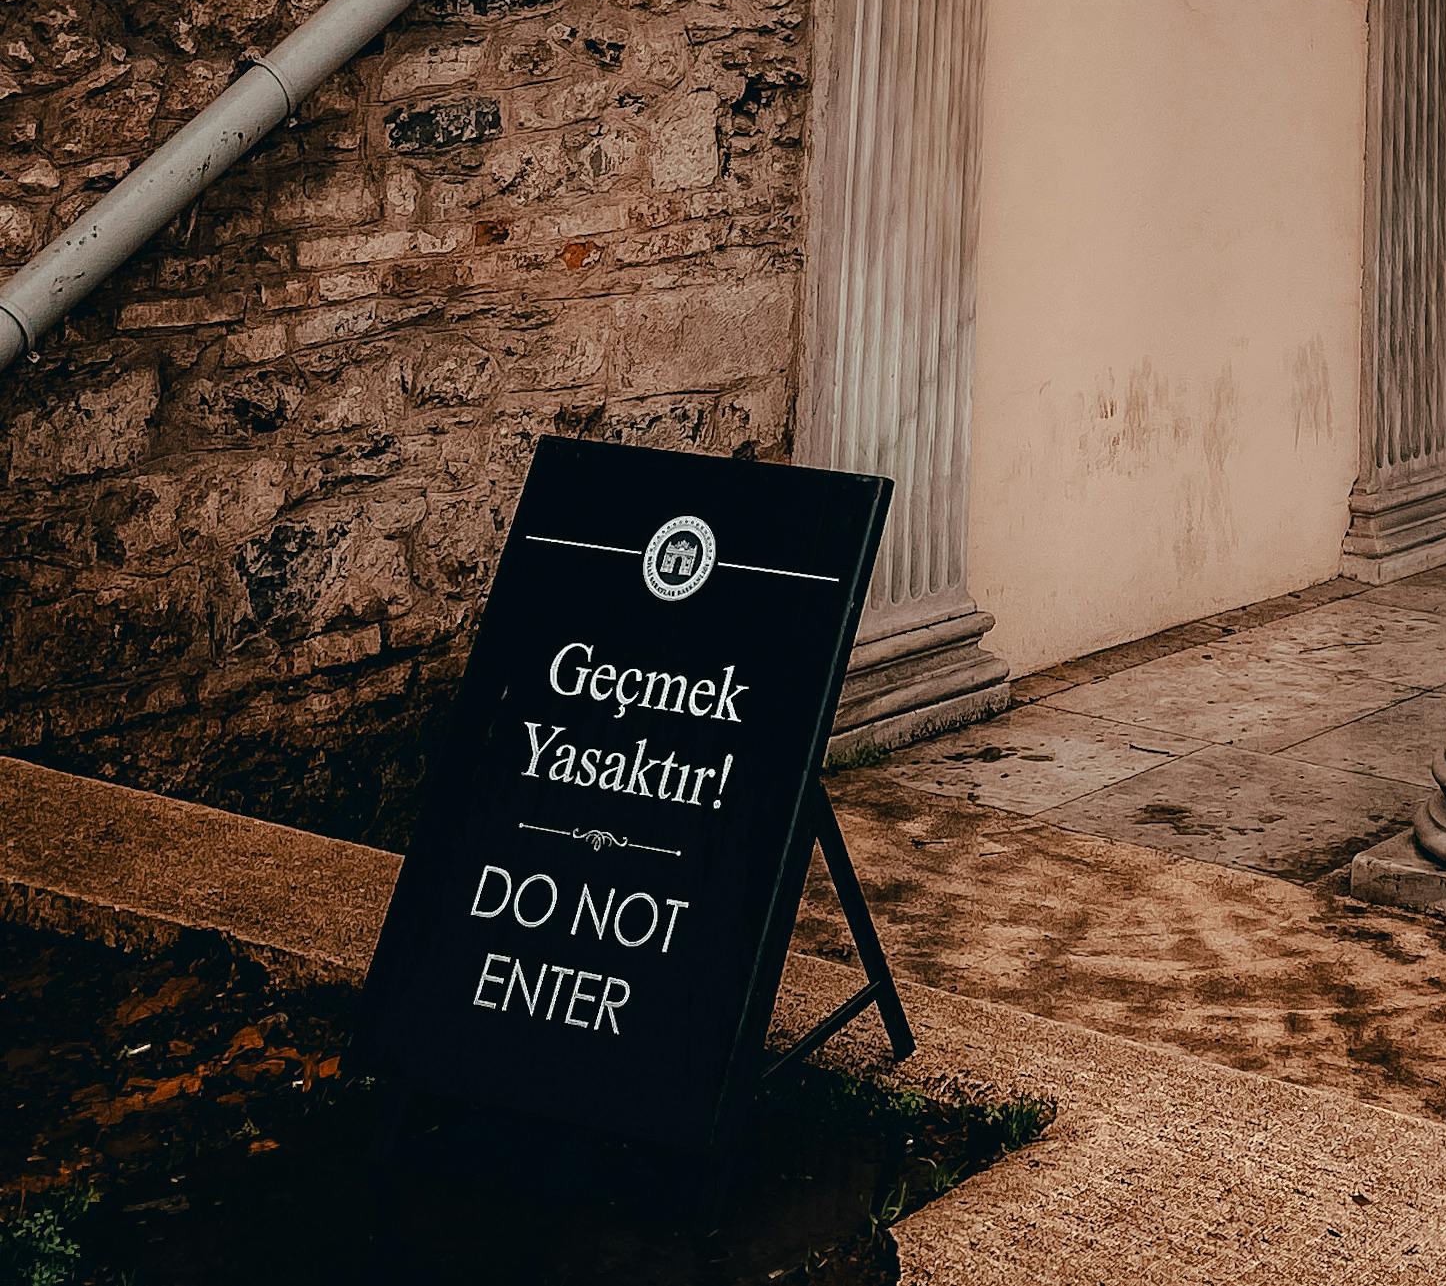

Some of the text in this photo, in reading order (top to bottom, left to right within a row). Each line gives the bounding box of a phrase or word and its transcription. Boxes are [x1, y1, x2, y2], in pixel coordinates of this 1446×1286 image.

[549, 642, 750, 723] Geçmek
[520, 721, 734, 810] Yasaktır!
[470, 864, 690, 953] DO NOT
[472, 952, 631, 1036] ENTER
